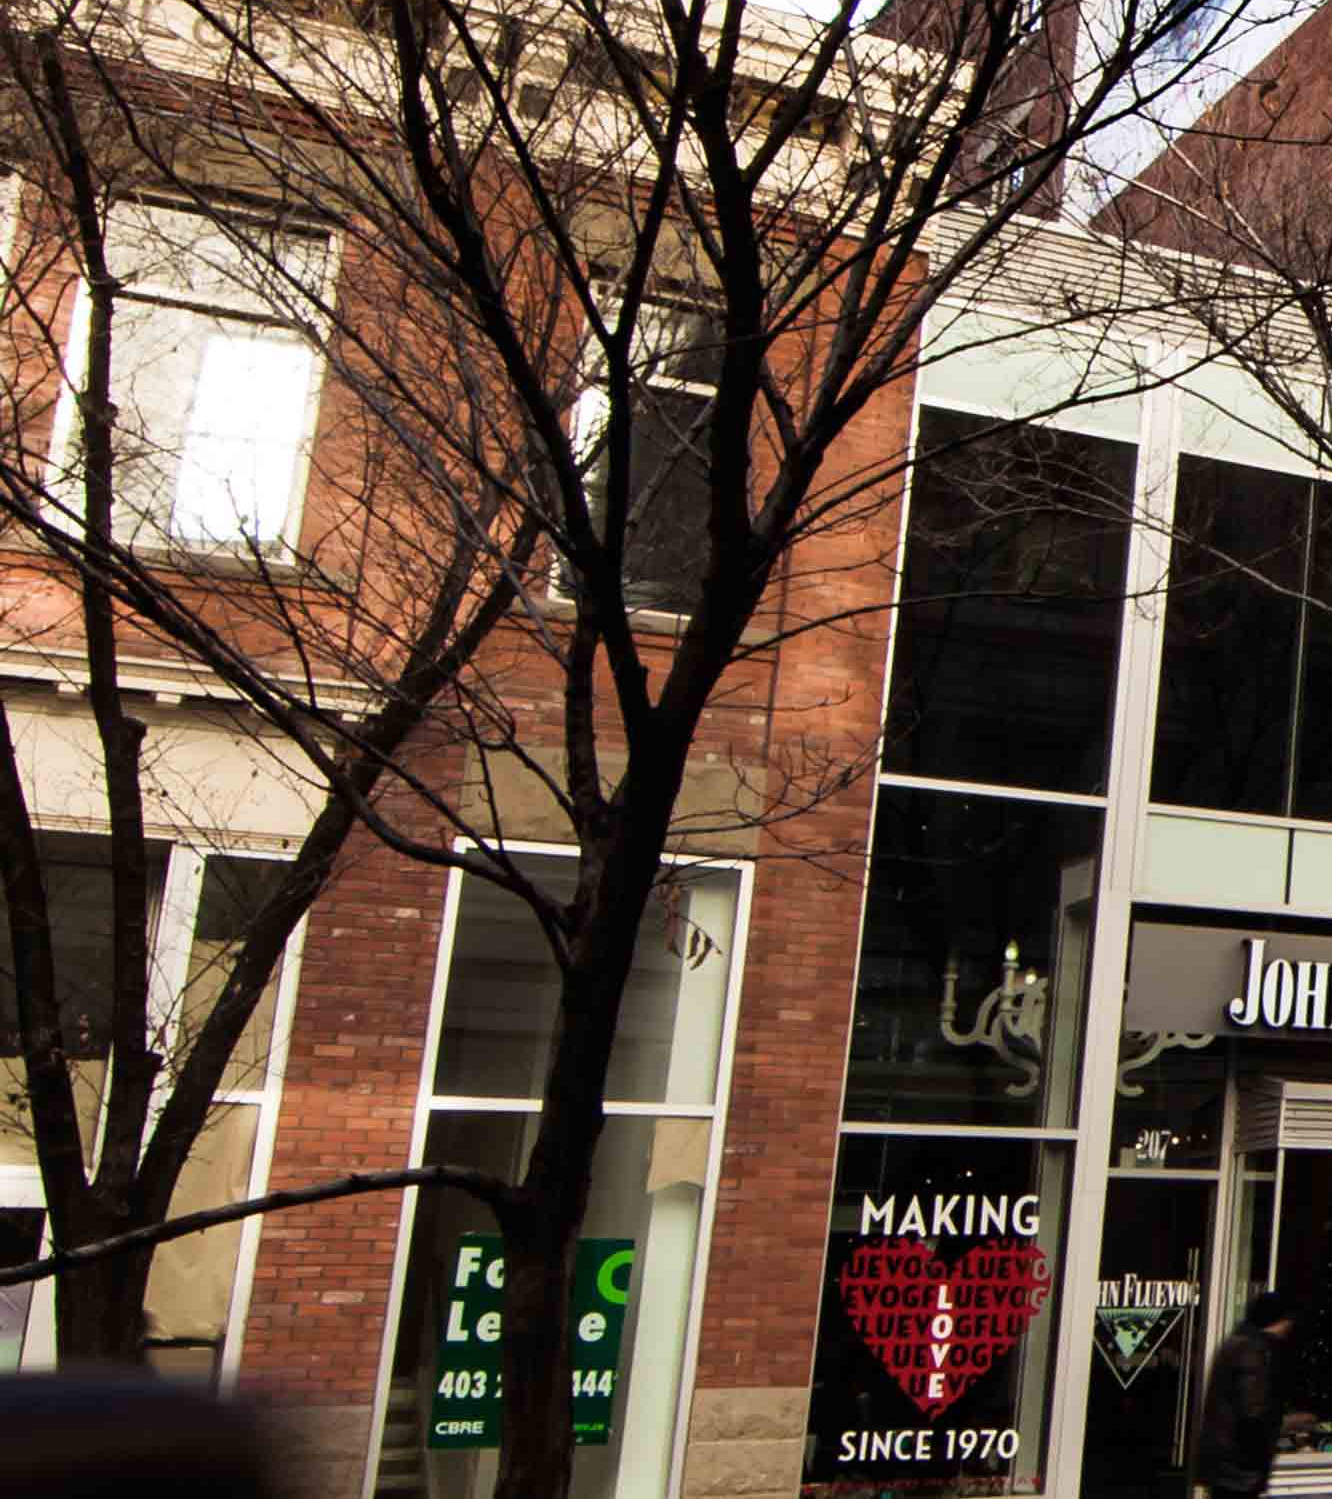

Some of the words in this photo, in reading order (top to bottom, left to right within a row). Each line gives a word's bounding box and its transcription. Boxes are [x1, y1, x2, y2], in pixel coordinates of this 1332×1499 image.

[861, 1194, 1040, 1238] MAKING
[454, 1246, 504, 1289] Fo
[446, 1300, 607, 1343] Lee
[927, 1284, 954, 1399] LOVE
[437, 1369, 488, 1399] 403
[434, 1420, 486, 1436] CBRE
[837, 1429, 934, 1462] SINCE
[945, 1428, 1021, 1460] 1970
